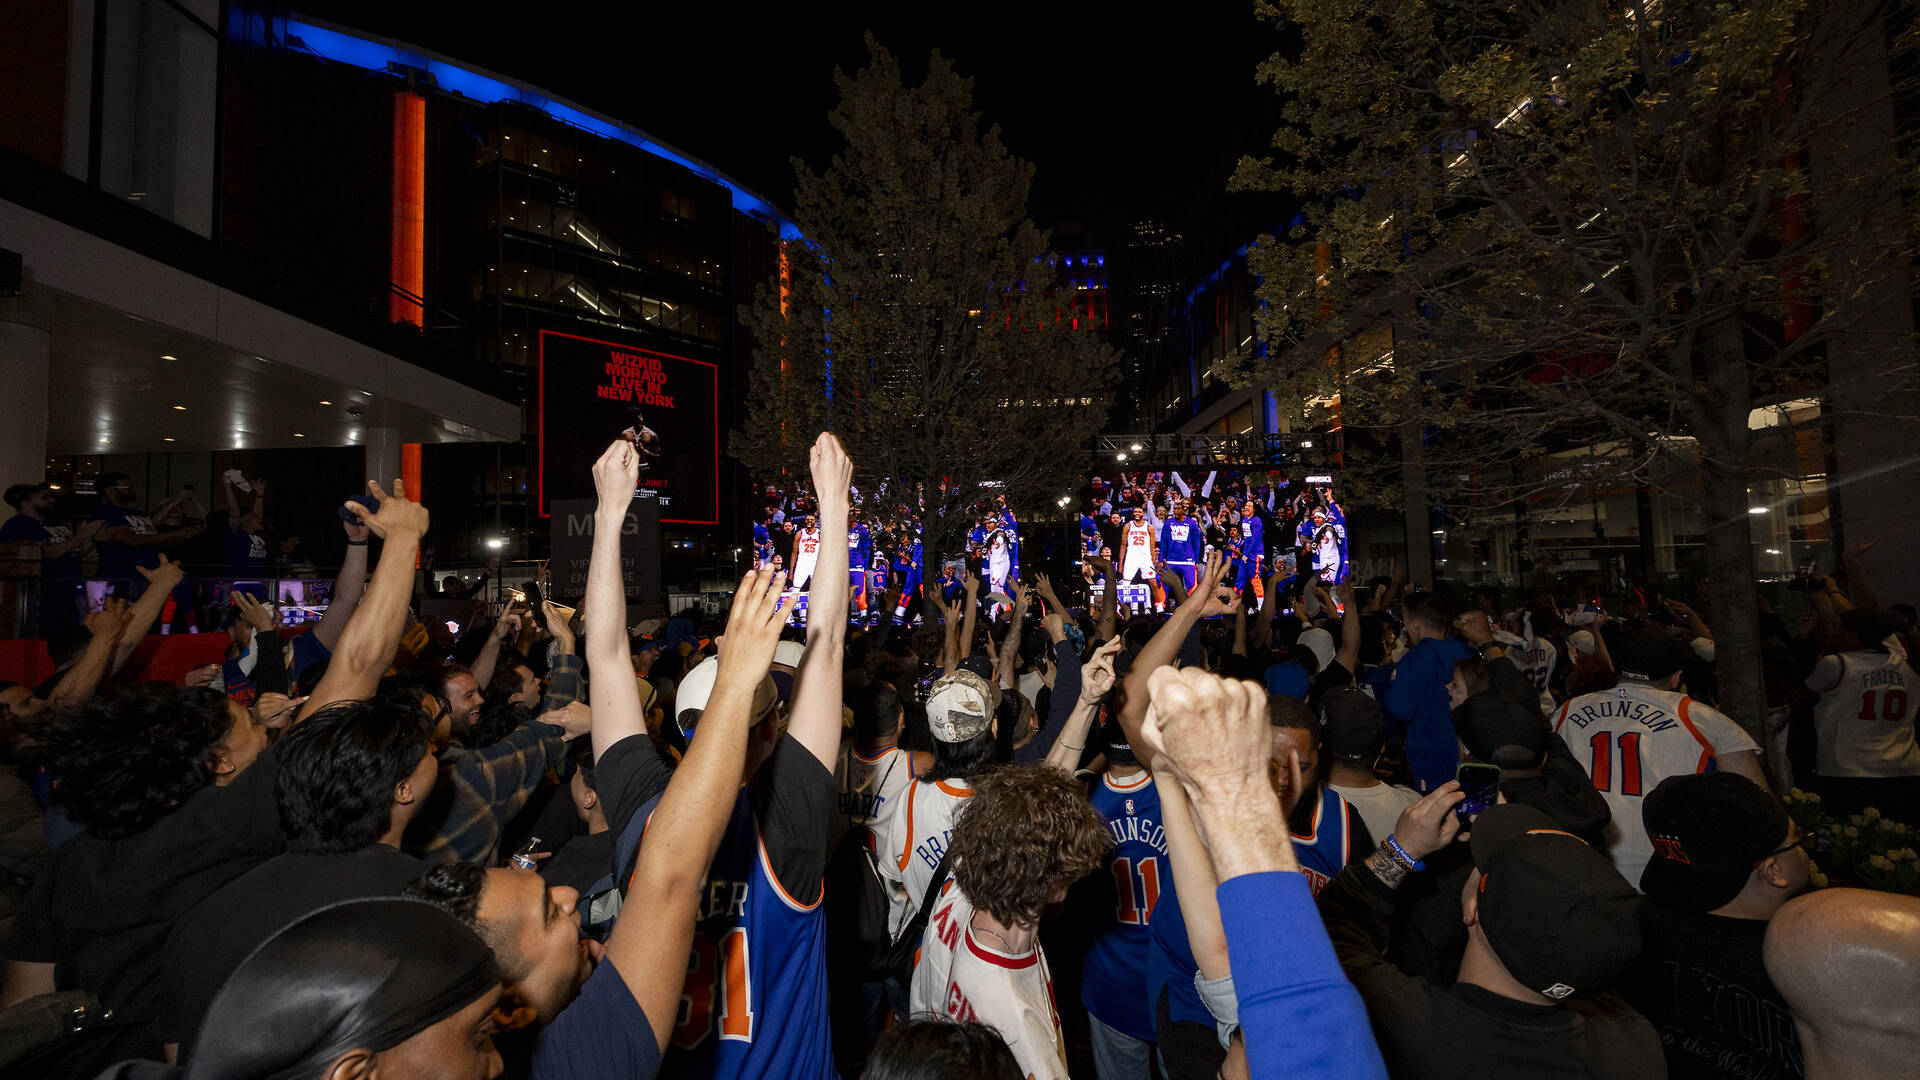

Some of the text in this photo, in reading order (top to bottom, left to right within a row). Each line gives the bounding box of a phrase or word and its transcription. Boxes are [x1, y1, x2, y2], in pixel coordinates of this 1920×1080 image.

[606, 362, 667, 384] MORAYO
[611, 352, 662, 371] WIZKID
[598, 385, 674, 408] NEW YORK
[612, 376, 661, 394] LIVE IN
[567, 513, 639, 536] MG
[804, 543, 816, 553] 25
[1133, 536, 1145, 546] 25
[1568, 700, 1680, 733] BRUNSON
[1858, 690, 1907, 721] 10
[1589, 730, 1643, 797] 11
[1112, 856, 1161, 926] 11
